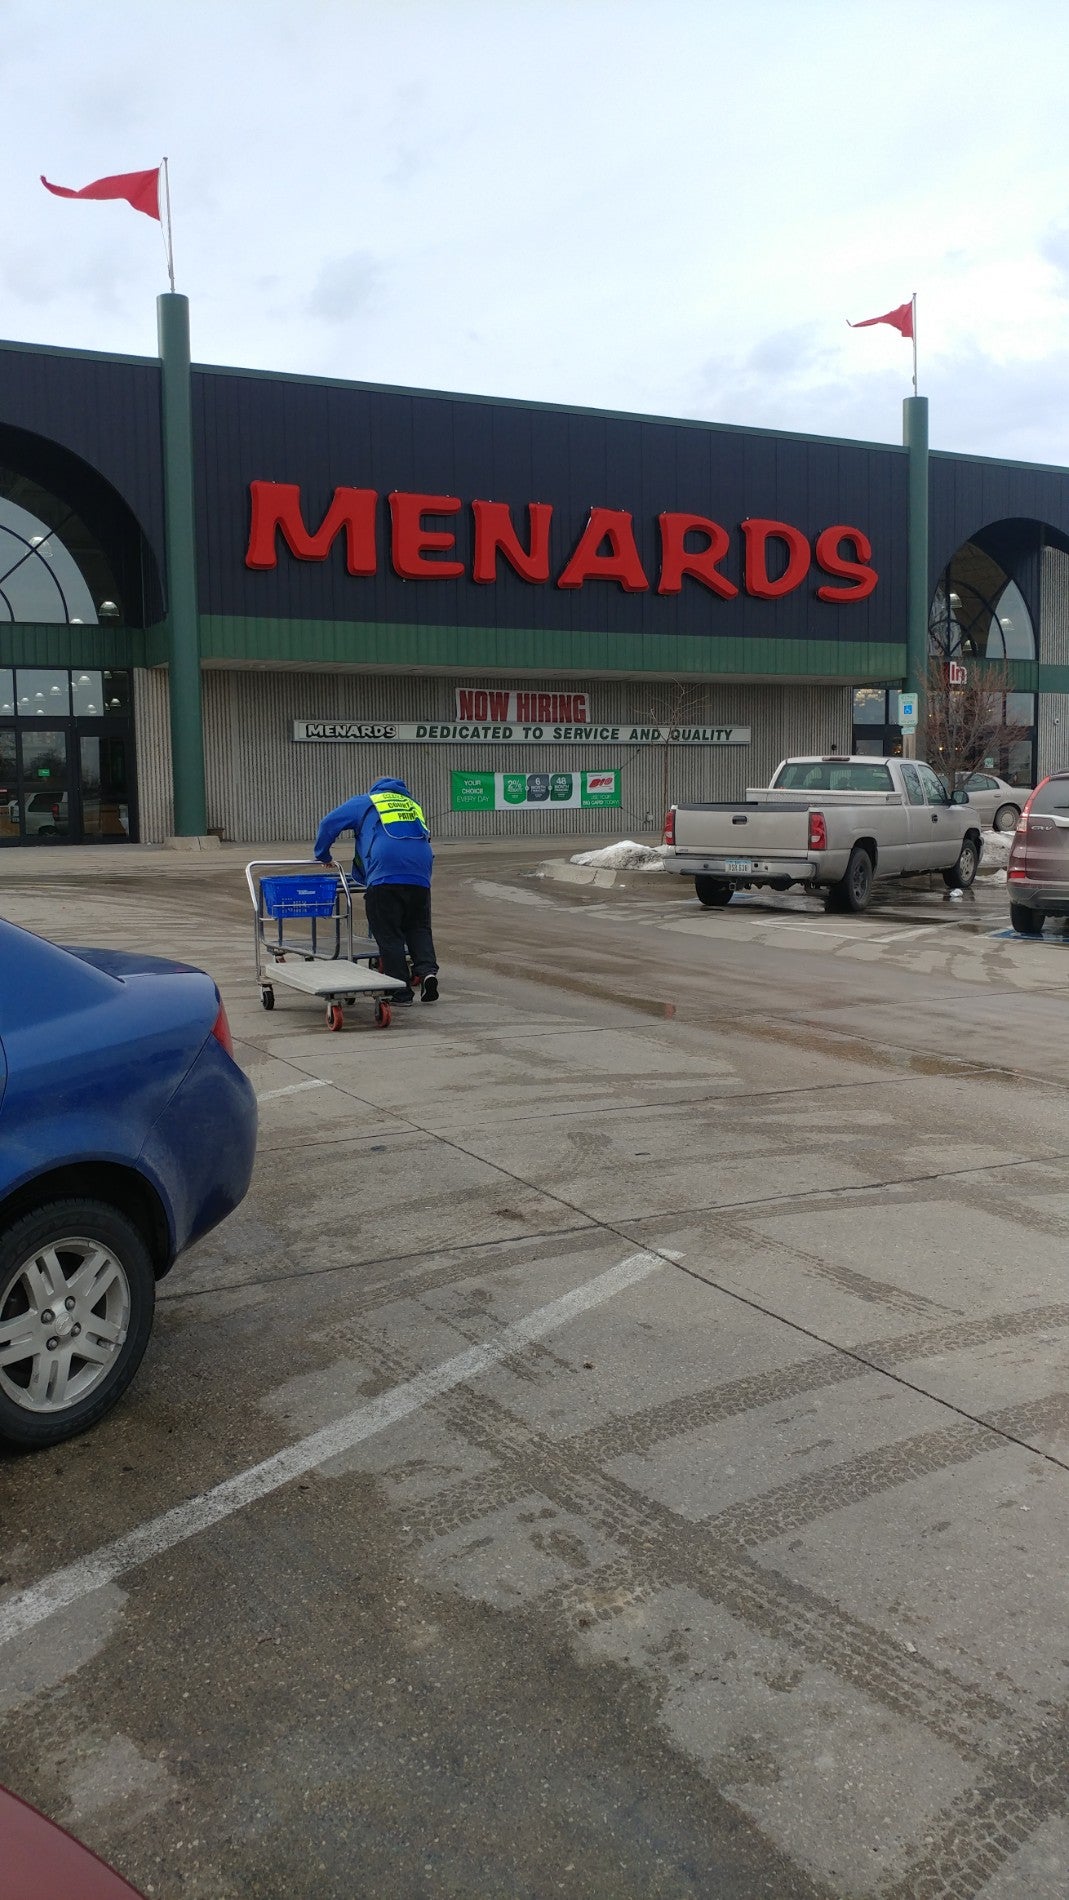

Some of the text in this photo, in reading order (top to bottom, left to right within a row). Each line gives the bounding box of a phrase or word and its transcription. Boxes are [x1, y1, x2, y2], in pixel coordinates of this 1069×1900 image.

[245, 480, 879, 604] MENARDS
[458, 690, 587, 724] NOW HIRING
[305, 723, 734, 742] MENARDS DEDICATED TO SERVICE AND QUALITY
[463, 779, 482, 787] YOUR
[507, 779, 523, 789] 2%
[535, 777, 541, 786] 6
[556, 777, 567, 785] 48
[461, 787, 484, 795] CHOICE
[456, 795, 490, 803] EVERY DAY
